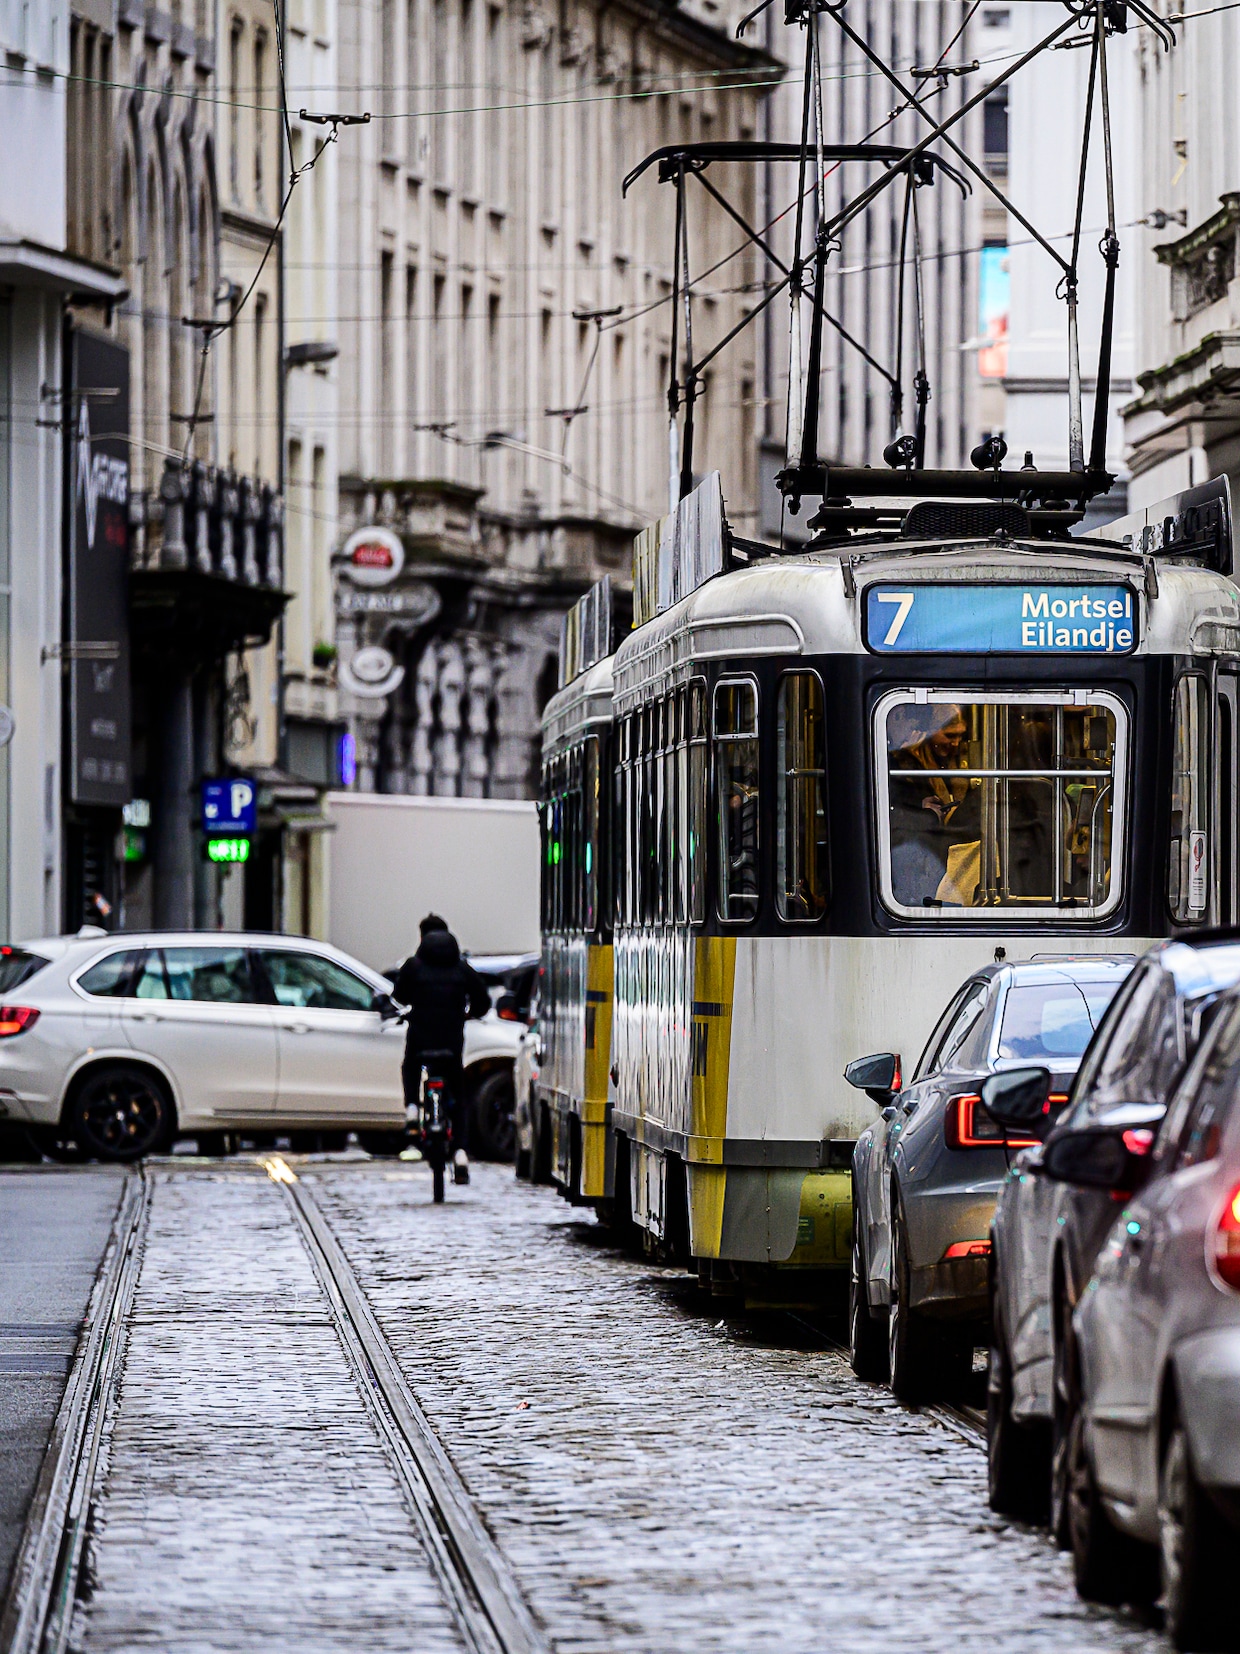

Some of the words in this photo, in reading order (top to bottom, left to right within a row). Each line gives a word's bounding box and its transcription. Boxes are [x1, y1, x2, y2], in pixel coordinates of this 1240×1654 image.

[877, 592, 915, 646] 7
[1021, 592, 1131, 618] Mortsel
[1021, 621, 1132, 652] Eilandje
[230, 783, 253, 819] P
